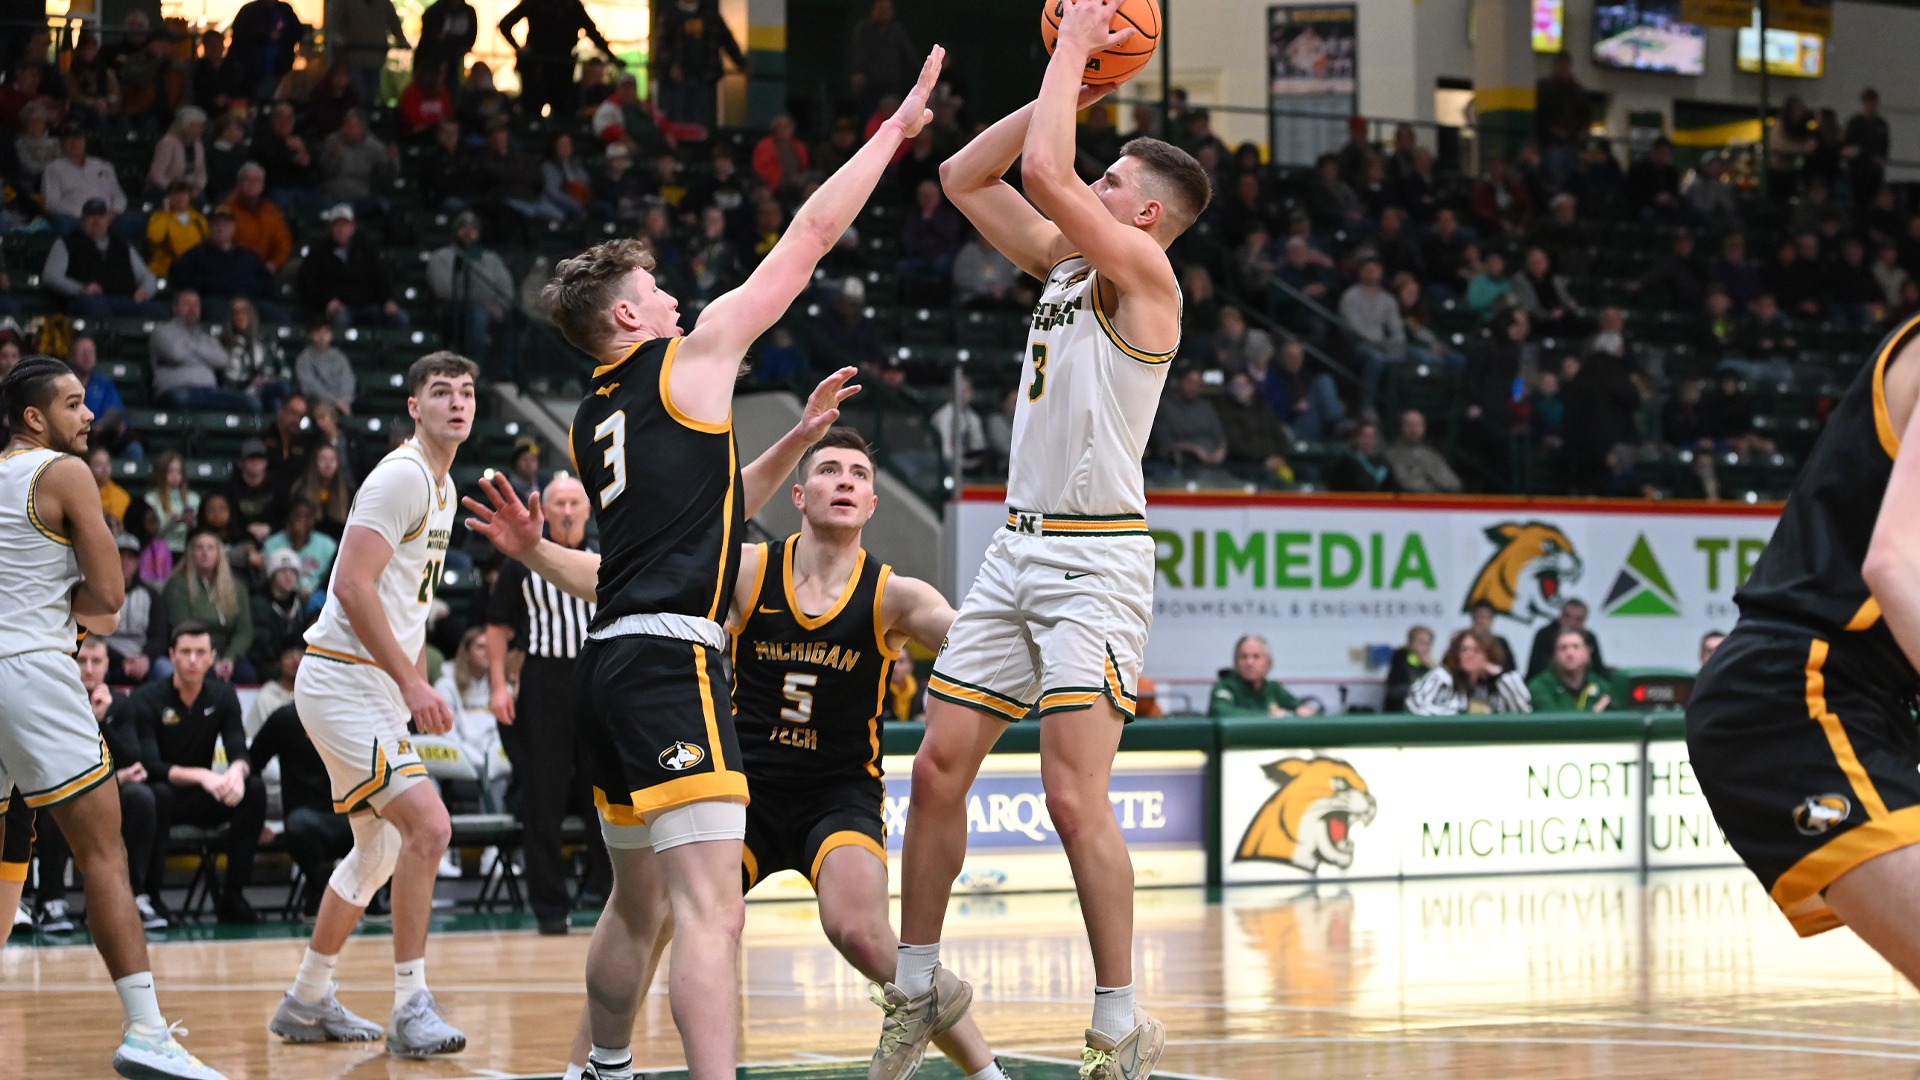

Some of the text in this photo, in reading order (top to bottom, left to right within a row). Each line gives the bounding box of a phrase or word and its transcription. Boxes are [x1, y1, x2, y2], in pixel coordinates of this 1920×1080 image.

[1028, 342, 1048, 403] 3
[594, 409, 626, 510] 3
[1019, 514, 1037, 534] N
[1150, 529, 1437, 590] RIMEDIA
[1310, 601, 1445, 618] ENGINEERING
[753, 640, 861, 672] MICHIGAN
[780, 672, 818, 724] 5
[1527, 760, 1698, 799] NORTHE
[1421, 816, 1624, 857] MICHIGAN
